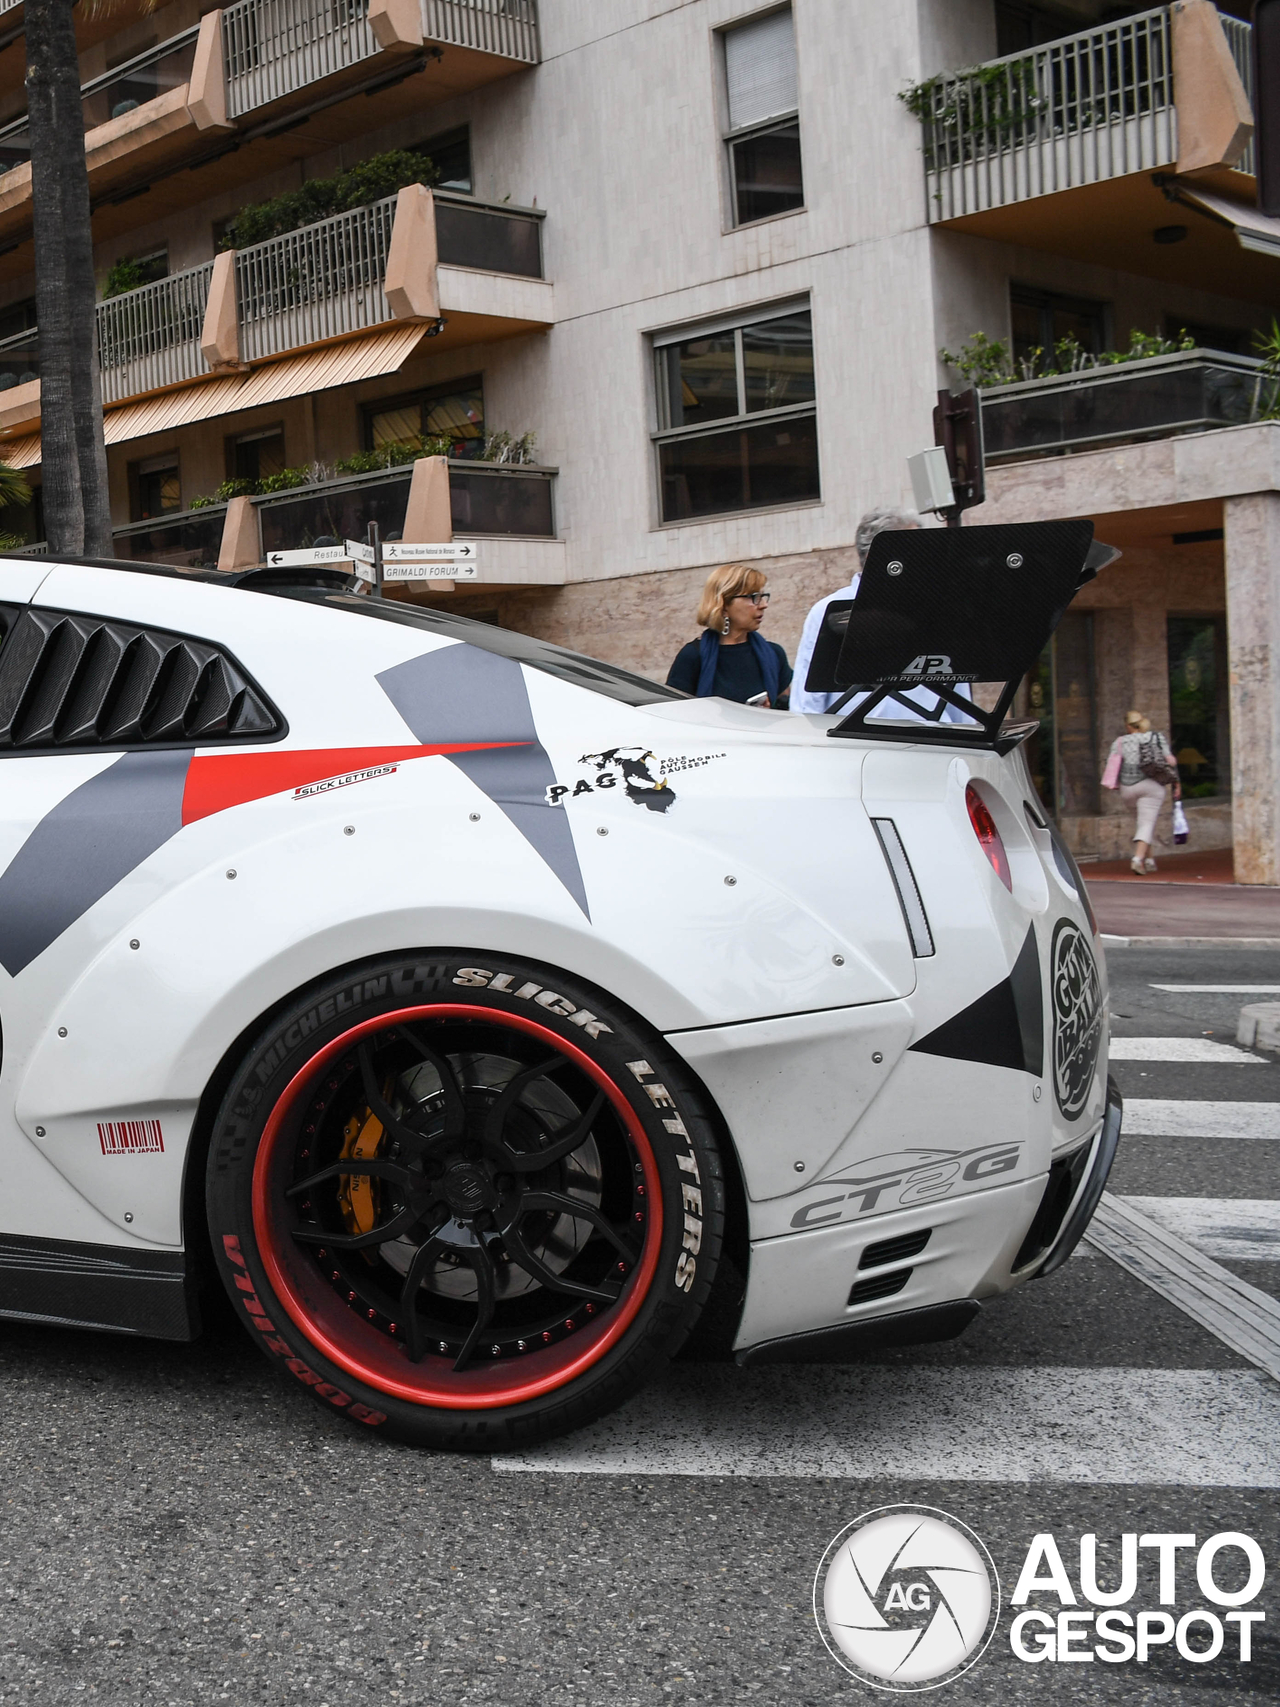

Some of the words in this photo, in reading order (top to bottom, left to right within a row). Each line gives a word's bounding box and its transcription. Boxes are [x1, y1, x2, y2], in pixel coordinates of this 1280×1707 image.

[386, 568, 427, 577] GRIMALDI
[429, 567, 459, 576] FORUM
[660, 752, 727, 770] AUTOMOBILE
[301, 780, 335, 795] SLICK
[338, 766, 391, 785] LETTERS
[549, 773, 618, 803] PAG
[254, 975, 388, 1083] MICHELIN
[452, 967, 615, 1040] SLICK
[625, 1058, 704, 1293] LETTERS
